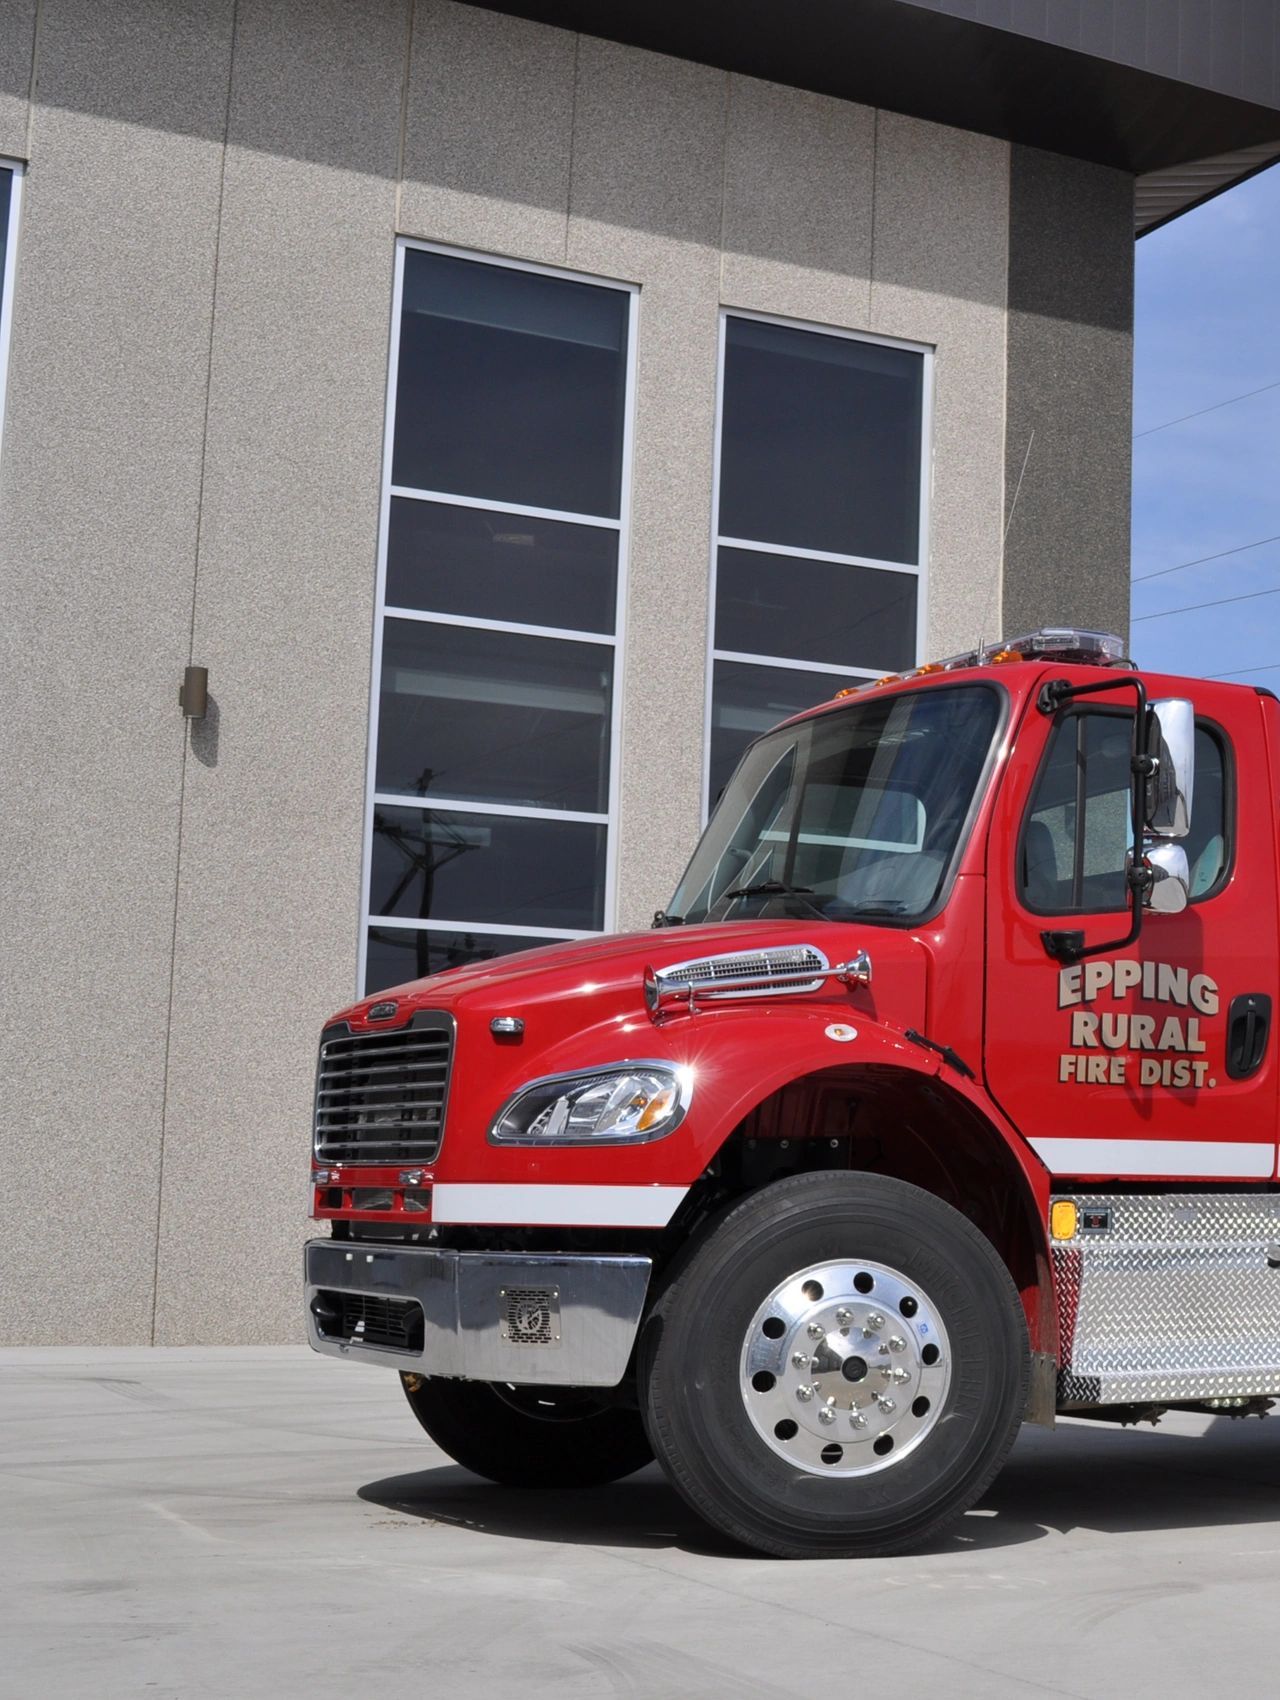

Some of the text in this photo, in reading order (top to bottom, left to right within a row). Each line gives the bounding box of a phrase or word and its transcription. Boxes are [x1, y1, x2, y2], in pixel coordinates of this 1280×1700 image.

[1058, 959, 1219, 1015] EPPING
[1071, 1011, 1206, 1052] RURAL
[1059, 1054, 1216, 1088] FIRE DIST.
[908, 1246, 985, 1420] MICHELIN
